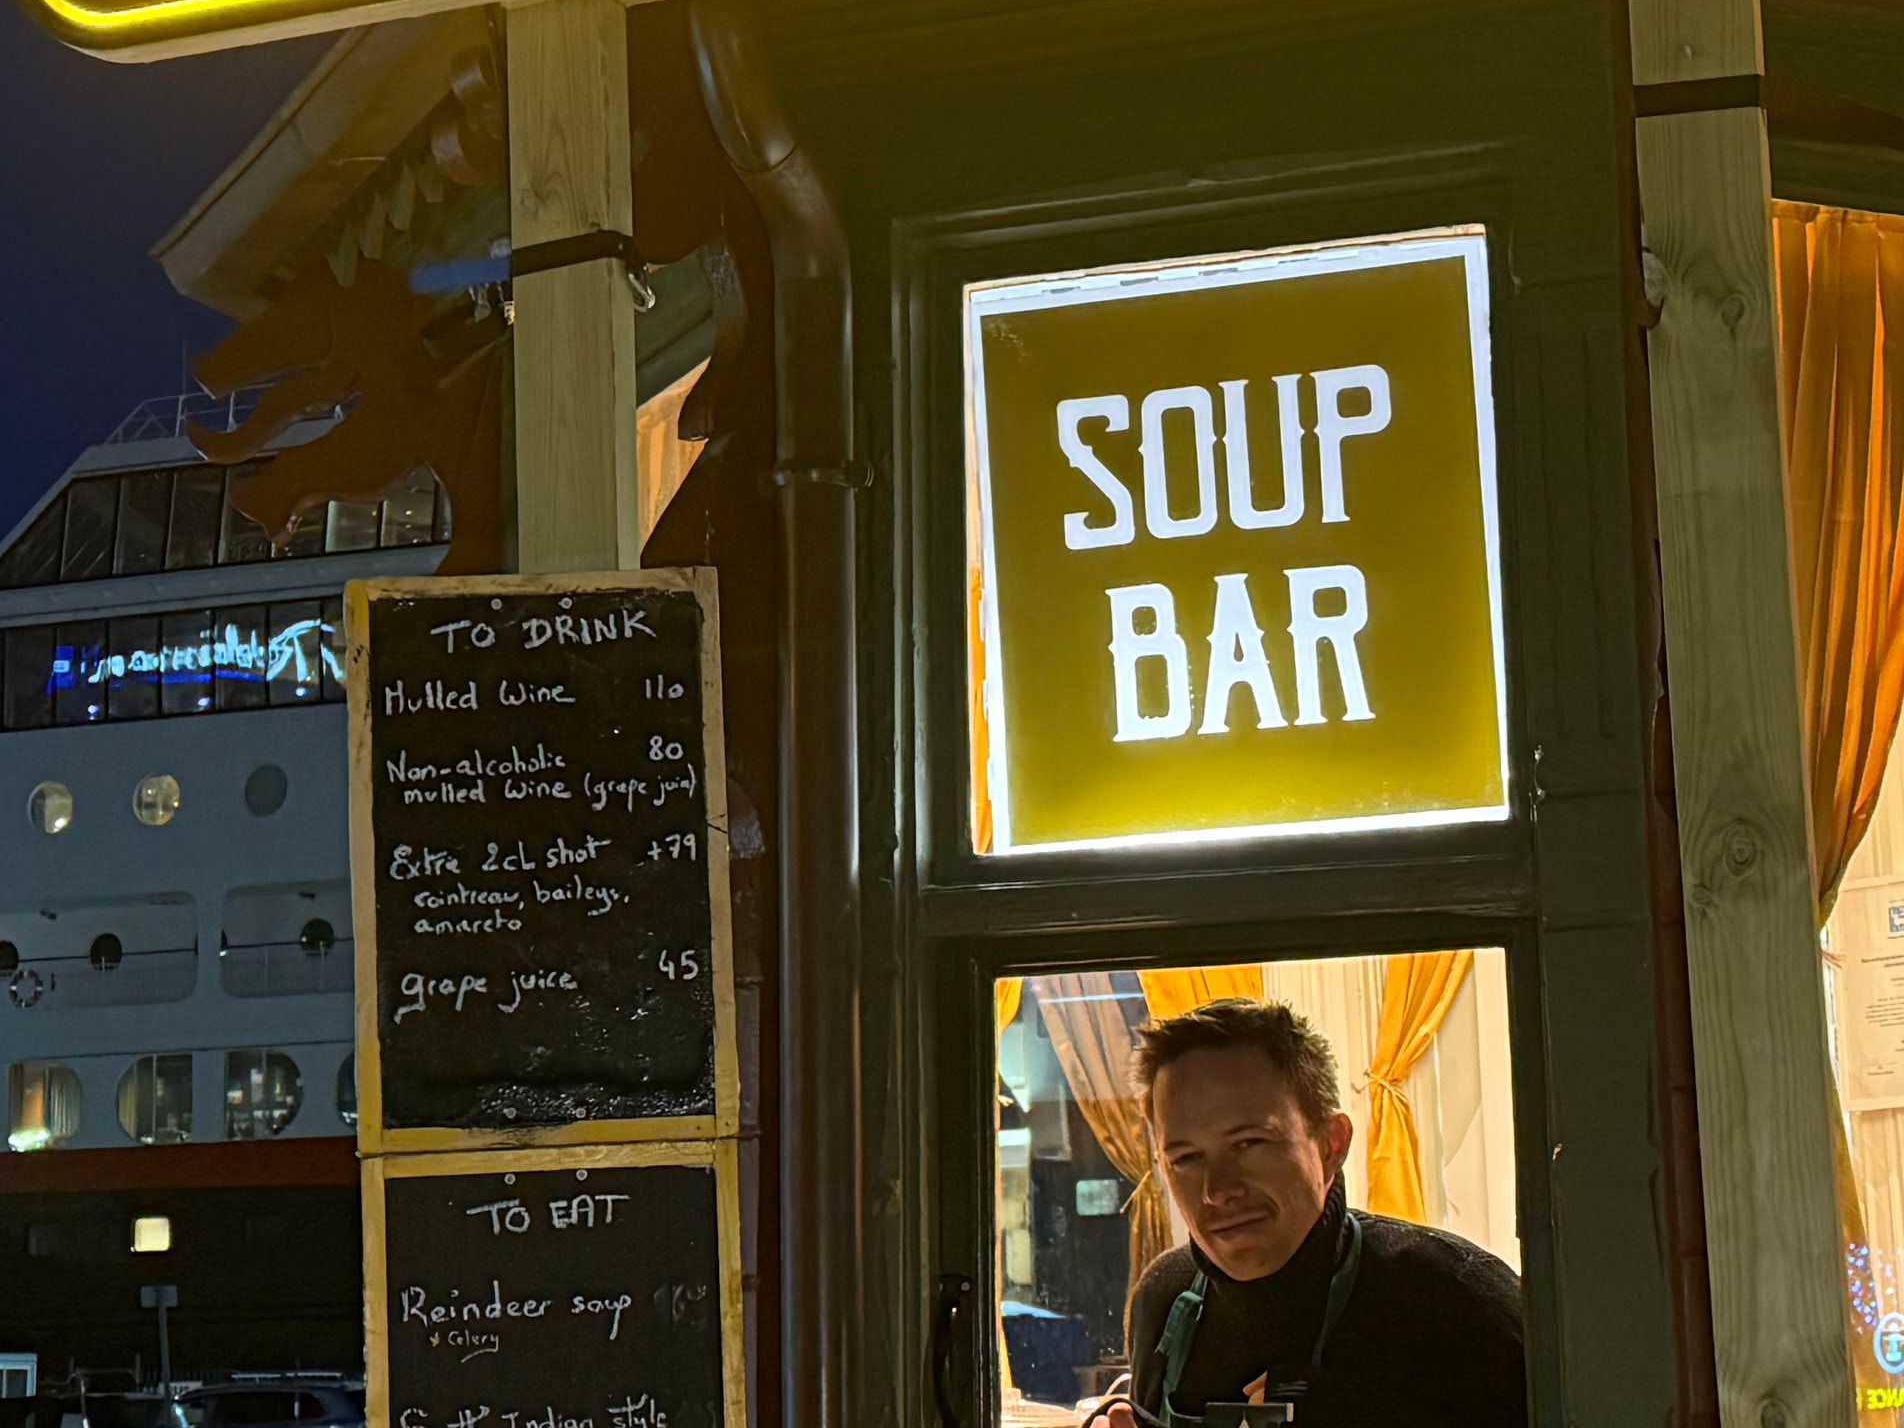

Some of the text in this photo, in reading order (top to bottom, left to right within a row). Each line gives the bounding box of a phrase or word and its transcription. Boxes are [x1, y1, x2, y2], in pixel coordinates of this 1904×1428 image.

[1057, 365, 1392, 550] SOUP
[430, 609, 656, 653] TO DRINK
[1105, 564, 1376, 742] BAR
[645, 674, 684, 700] 110
[387, 735, 684, 784] Non-alcoholic 80
[403, 779, 486, 805] mulled
[390, 843, 461, 880] Extra
[546, 834, 612, 869] shot
[394, 950, 699, 1024] grape juice 45
[466, 1194, 631, 1235] TO EAT
[400, 1280, 552, 1327] Reindeer
[571, 1294, 632, 1340] soup
